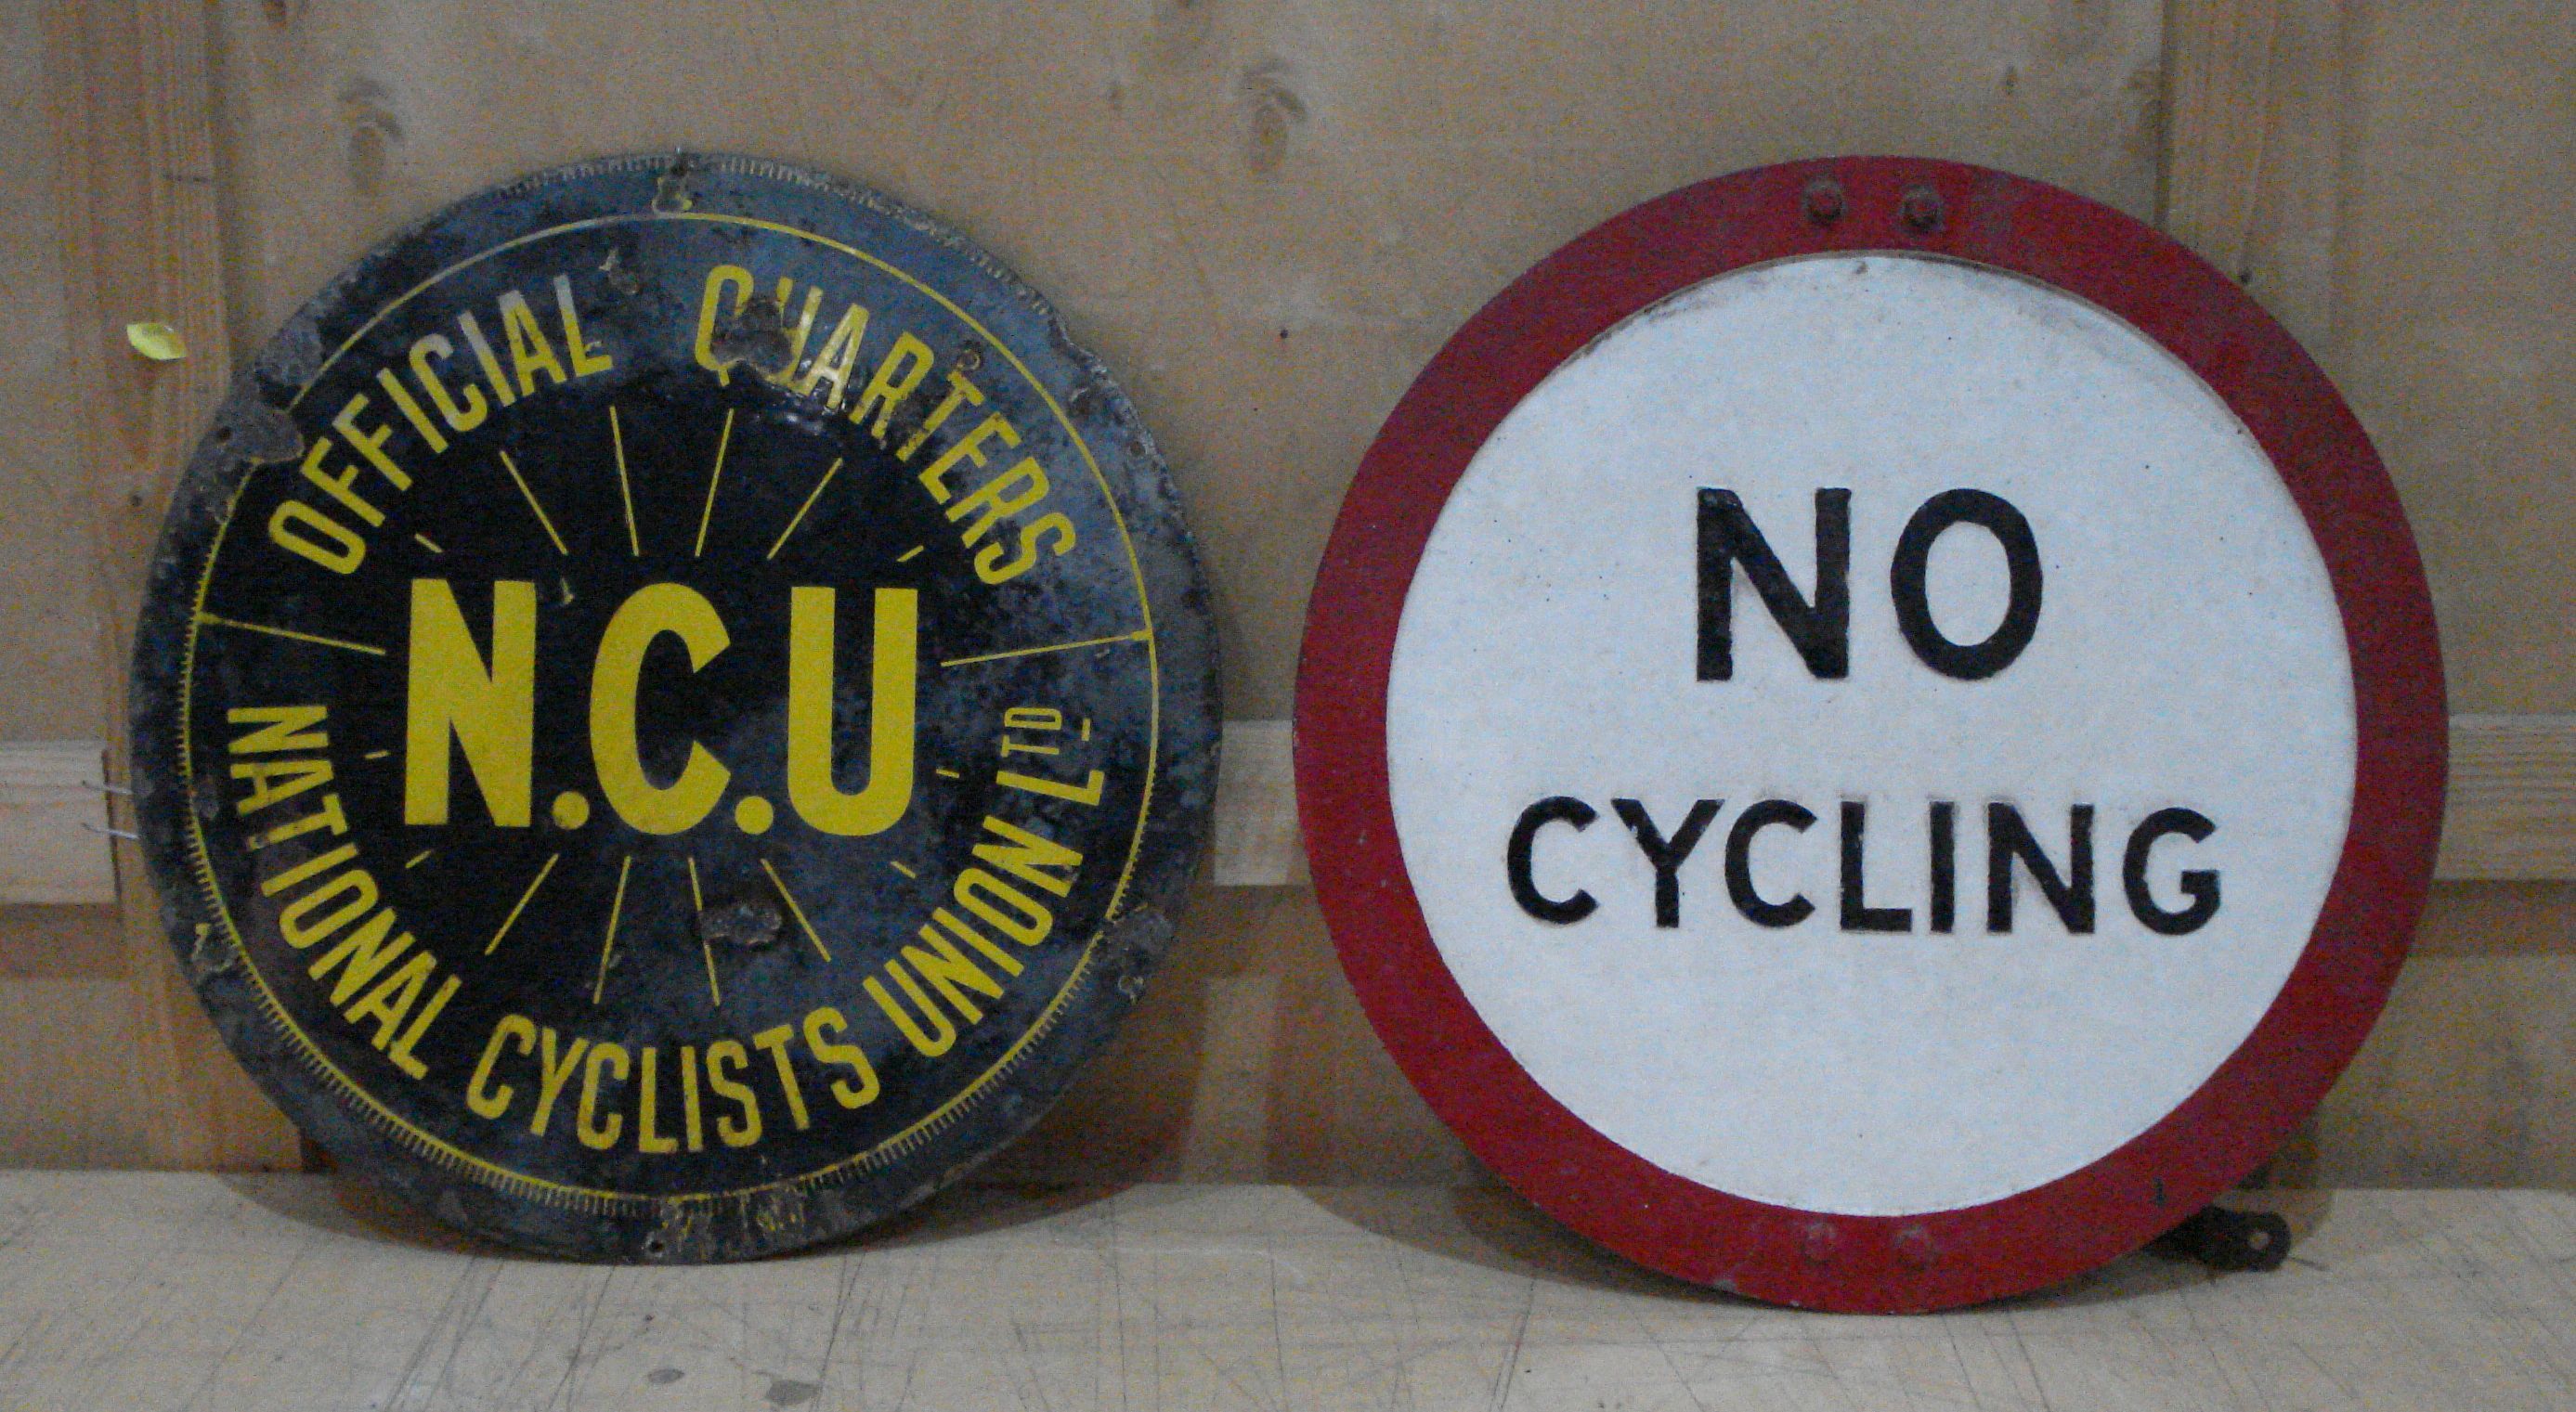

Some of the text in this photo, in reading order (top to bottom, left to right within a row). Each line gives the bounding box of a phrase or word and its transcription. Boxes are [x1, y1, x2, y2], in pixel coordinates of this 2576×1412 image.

[268, 265, 1076, 584] OFFICIAL QUARTERS
[403, 576, 919, 839] N.C.U
[1697, 487, 2043, 681] NO
[228, 705, 462, 1081] NATIONAL
[467, 1007, 880, 1153] CYCLISTS
[863, 815, 1084, 1057] UNION
[1507, 796, 2222, 936] CYCLING
